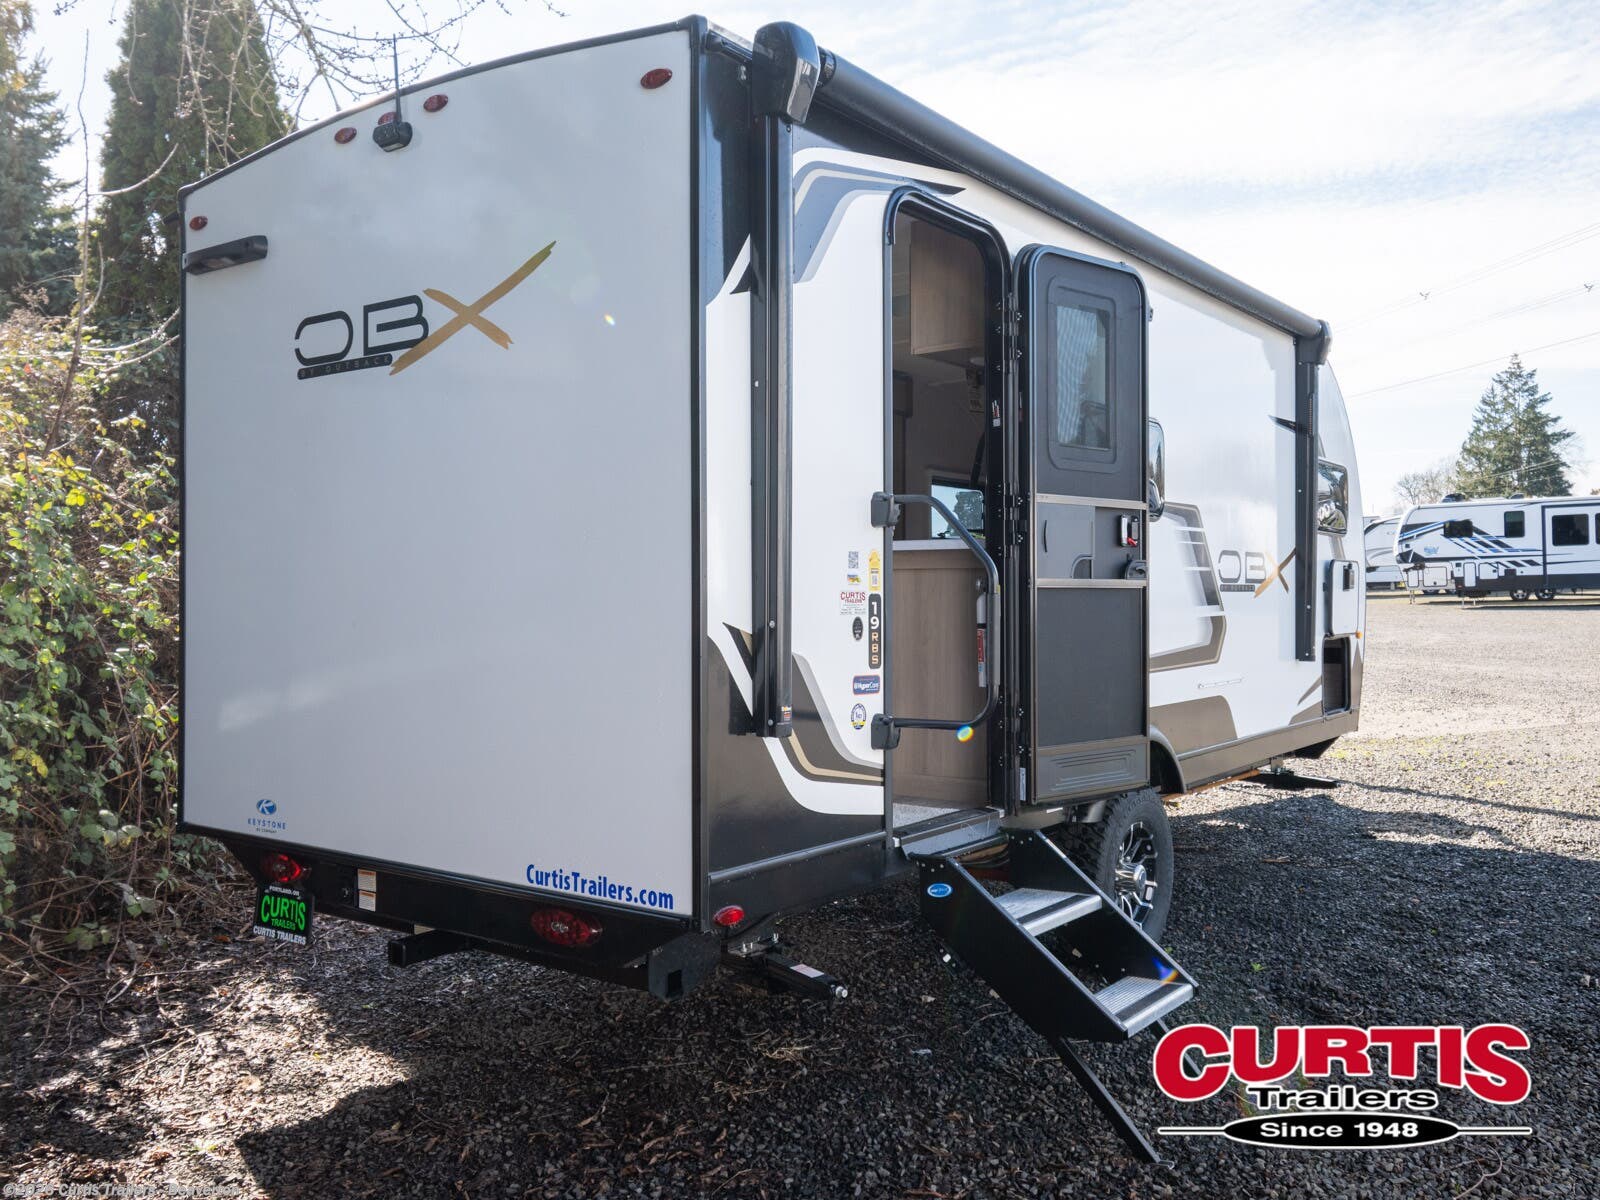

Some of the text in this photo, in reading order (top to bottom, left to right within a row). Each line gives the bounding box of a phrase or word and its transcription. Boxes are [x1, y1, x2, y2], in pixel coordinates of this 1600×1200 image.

[295, 240, 557, 376] OBX
[325, 354, 391, 374] OUTBACK
[1218, 547, 1297, 598] OBX
[840, 591, 866, 601] CURTIS
[247, 818, 287, 830] KEYSTONE
[526, 864, 674, 910] CurtisTrailers.com
[261, 895, 306, 931] CURTIS
[271, 918, 296, 931] TRAILERS
[253, 925, 307, 945] CURTIS TRAILERS
